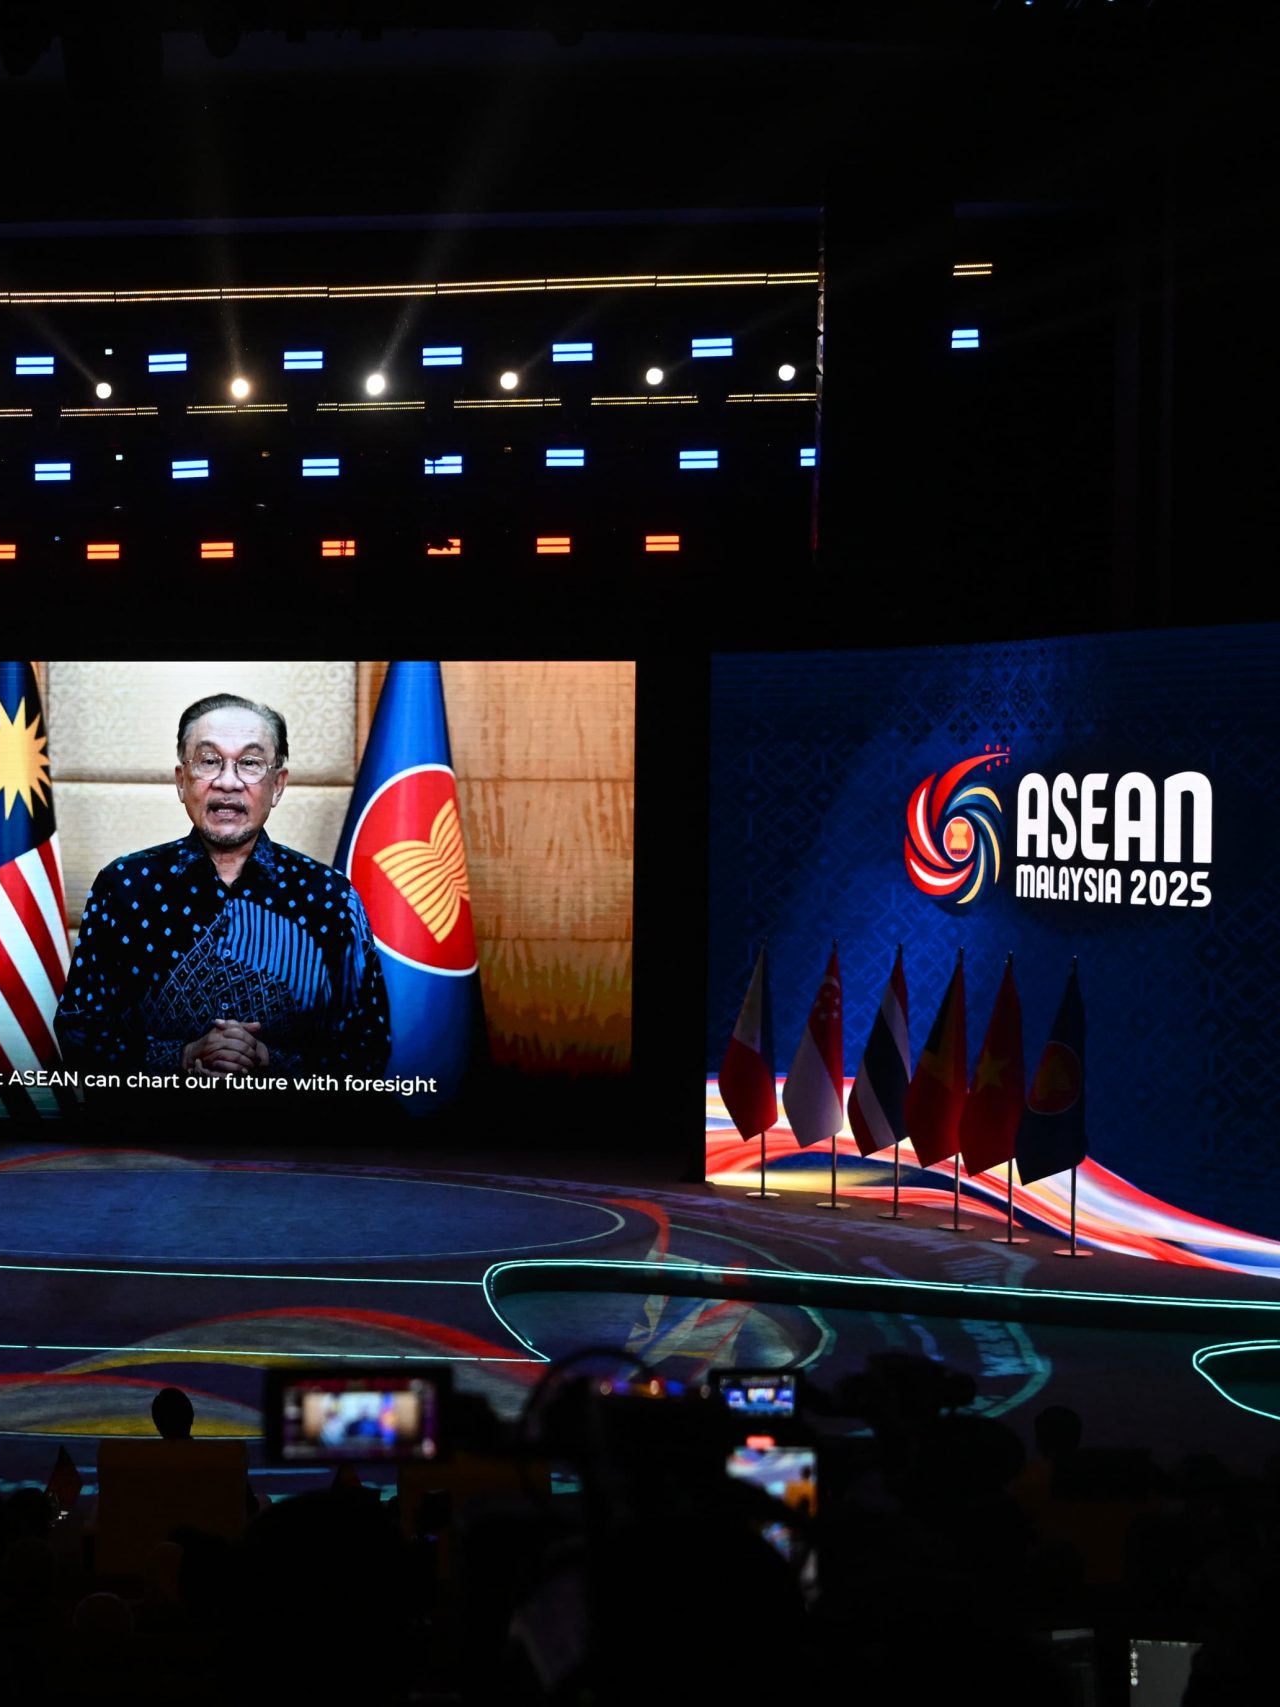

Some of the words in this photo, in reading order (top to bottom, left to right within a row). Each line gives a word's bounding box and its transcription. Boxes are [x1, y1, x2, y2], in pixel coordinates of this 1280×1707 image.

[1017, 771, 1212, 863] ASEAN
[1015, 863, 1122, 904] MALAYSIA
[1130, 869, 1212, 908] 2025
[7, 1069, 78, 1087] ASEAN
[83, 1074, 121, 1088] can
[125, 1070, 179, 1089] chart
[184, 1076, 220, 1090] our
[223, 1072, 288, 1091] future
[292, 1073, 339, 1091] with
[343, 1073, 437, 1098] foresight
